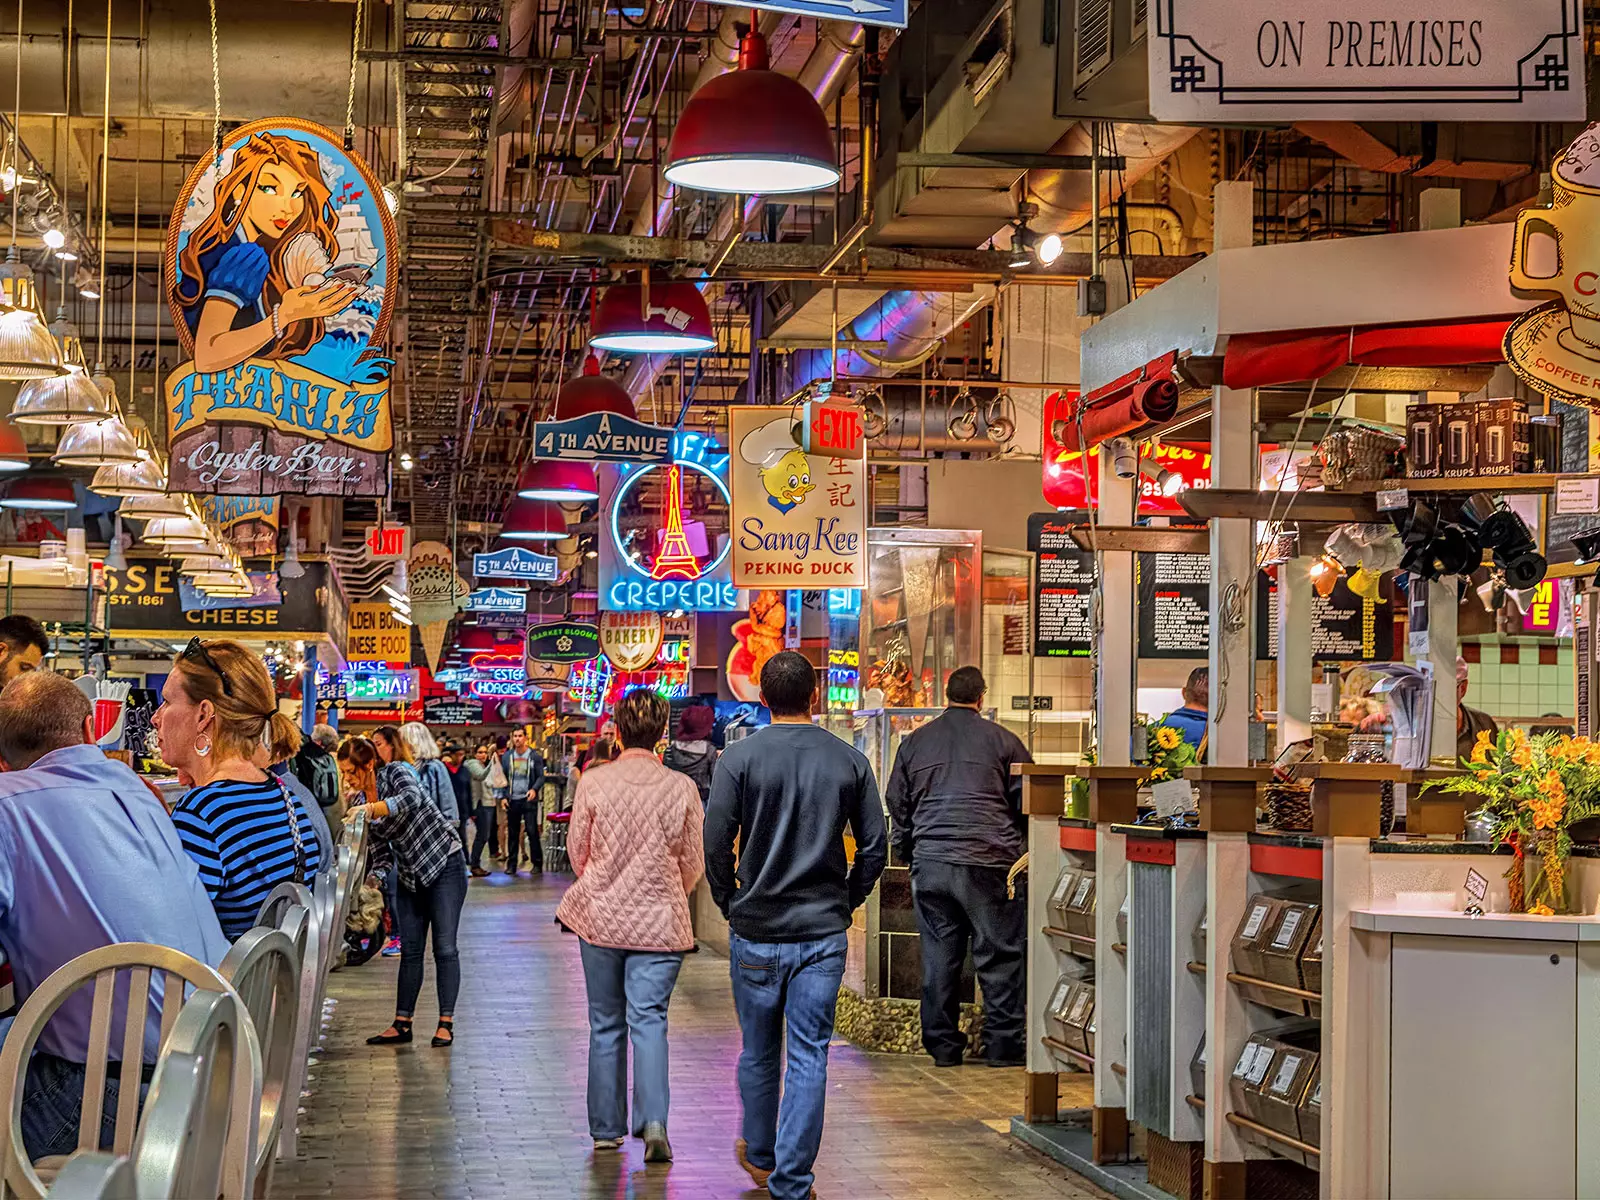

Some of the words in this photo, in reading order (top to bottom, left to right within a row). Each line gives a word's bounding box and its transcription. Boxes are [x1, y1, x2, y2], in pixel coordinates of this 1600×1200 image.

[1257, 20, 1305, 68] ON
[1326, 20, 1482, 68] PREMISES
[1535, 357, 1591, 387] COFFEE
[172, 361, 389, 439] PEARL'S
[819, 407, 858, 451] EXIT
[583, 434, 669, 455] AVENUE
[187, 440, 286, 484] Oyster
[280, 440, 357, 477] Bar
[1480, 465, 1510, 475] KRUPS
[1408, 469, 1438, 478] KRUPS
[1444, 468, 1474, 478] KRUPS
[372, 528, 405, 556] EXIT
[739, 516, 811, 560] Sang
[812, 515, 858, 556] Kee
[478, 560, 500, 573] 5TH
[503, 561, 554, 573] AVENUE
[744, 562, 804, 575] PEKING
[810, 562, 855, 574] DUCK
[138, 596, 164, 606] 1861
[484, 598, 522, 606] AVENUE
[611, 581, 737, 607] CREPERIE
[186, 609, 279, 625] CHEESE
[608, 612, 652, 627] MARKET
[530, 628, 562, 641] MARKET
[564, 628, 598, 641] BLOOMS
[606, 628, 656, 644] BAKERY
[380, 636, 406, 654] FOOD
[479, 682, 524, 694] HOAGIES
